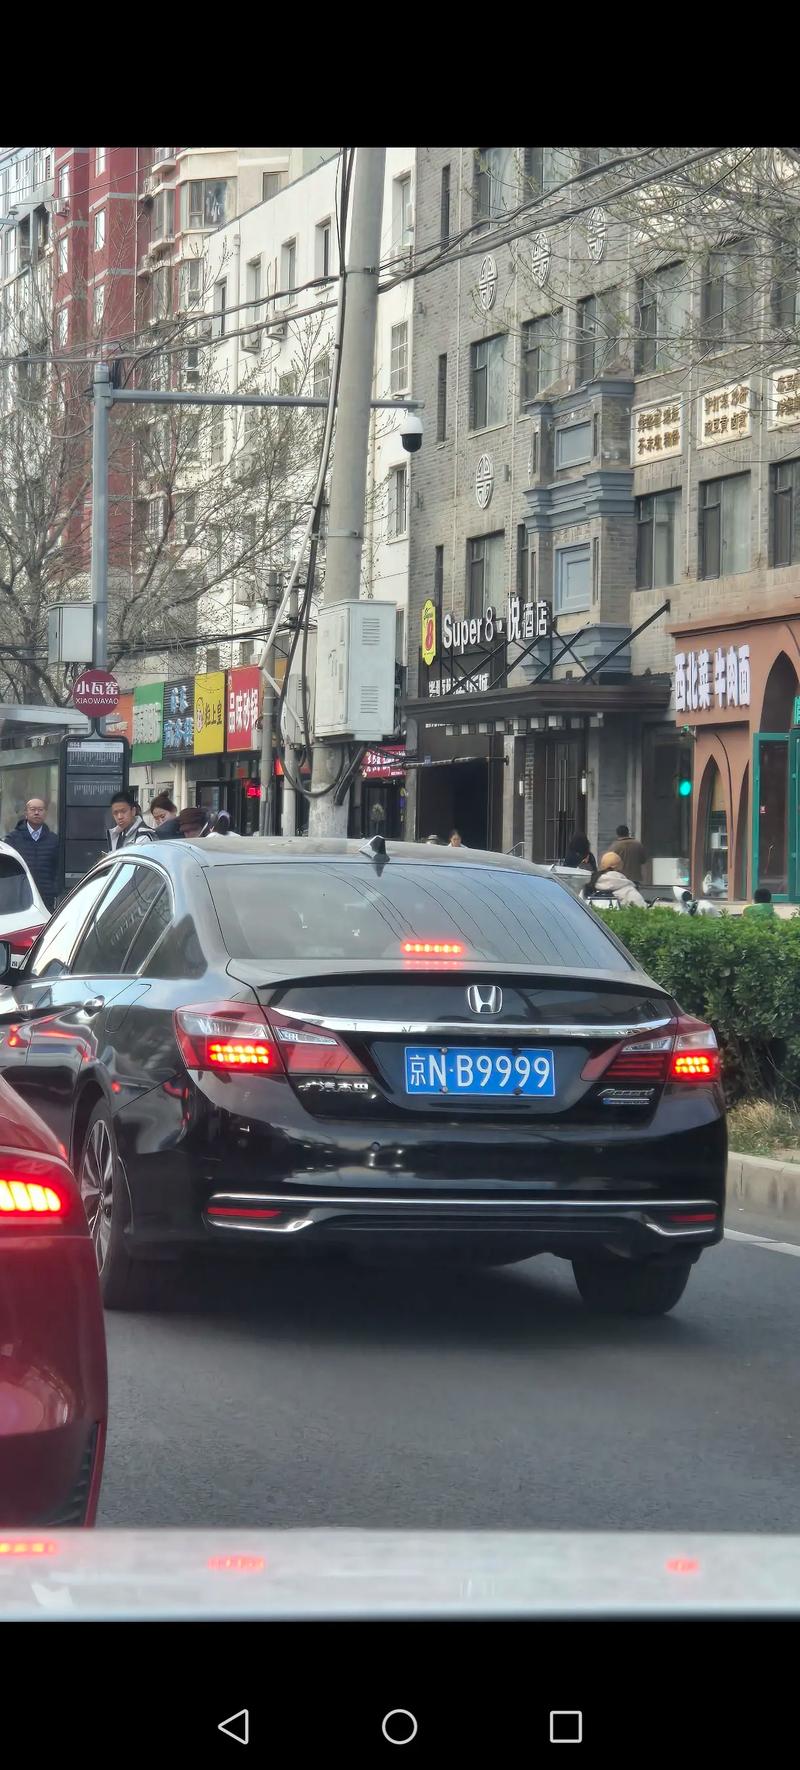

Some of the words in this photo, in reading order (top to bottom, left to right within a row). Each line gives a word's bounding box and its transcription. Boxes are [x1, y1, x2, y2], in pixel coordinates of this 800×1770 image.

[443, 614, 483, 654] Super
[485, 606, 494, 642] 8
[76, 680, 119, 696] 小瓦窑
[714, 644, 751, 709] 牛肉面
[75, 697, 119, 705] XIAOWAYAO
[409, 1054, 551, 1089] 京N·B9999
